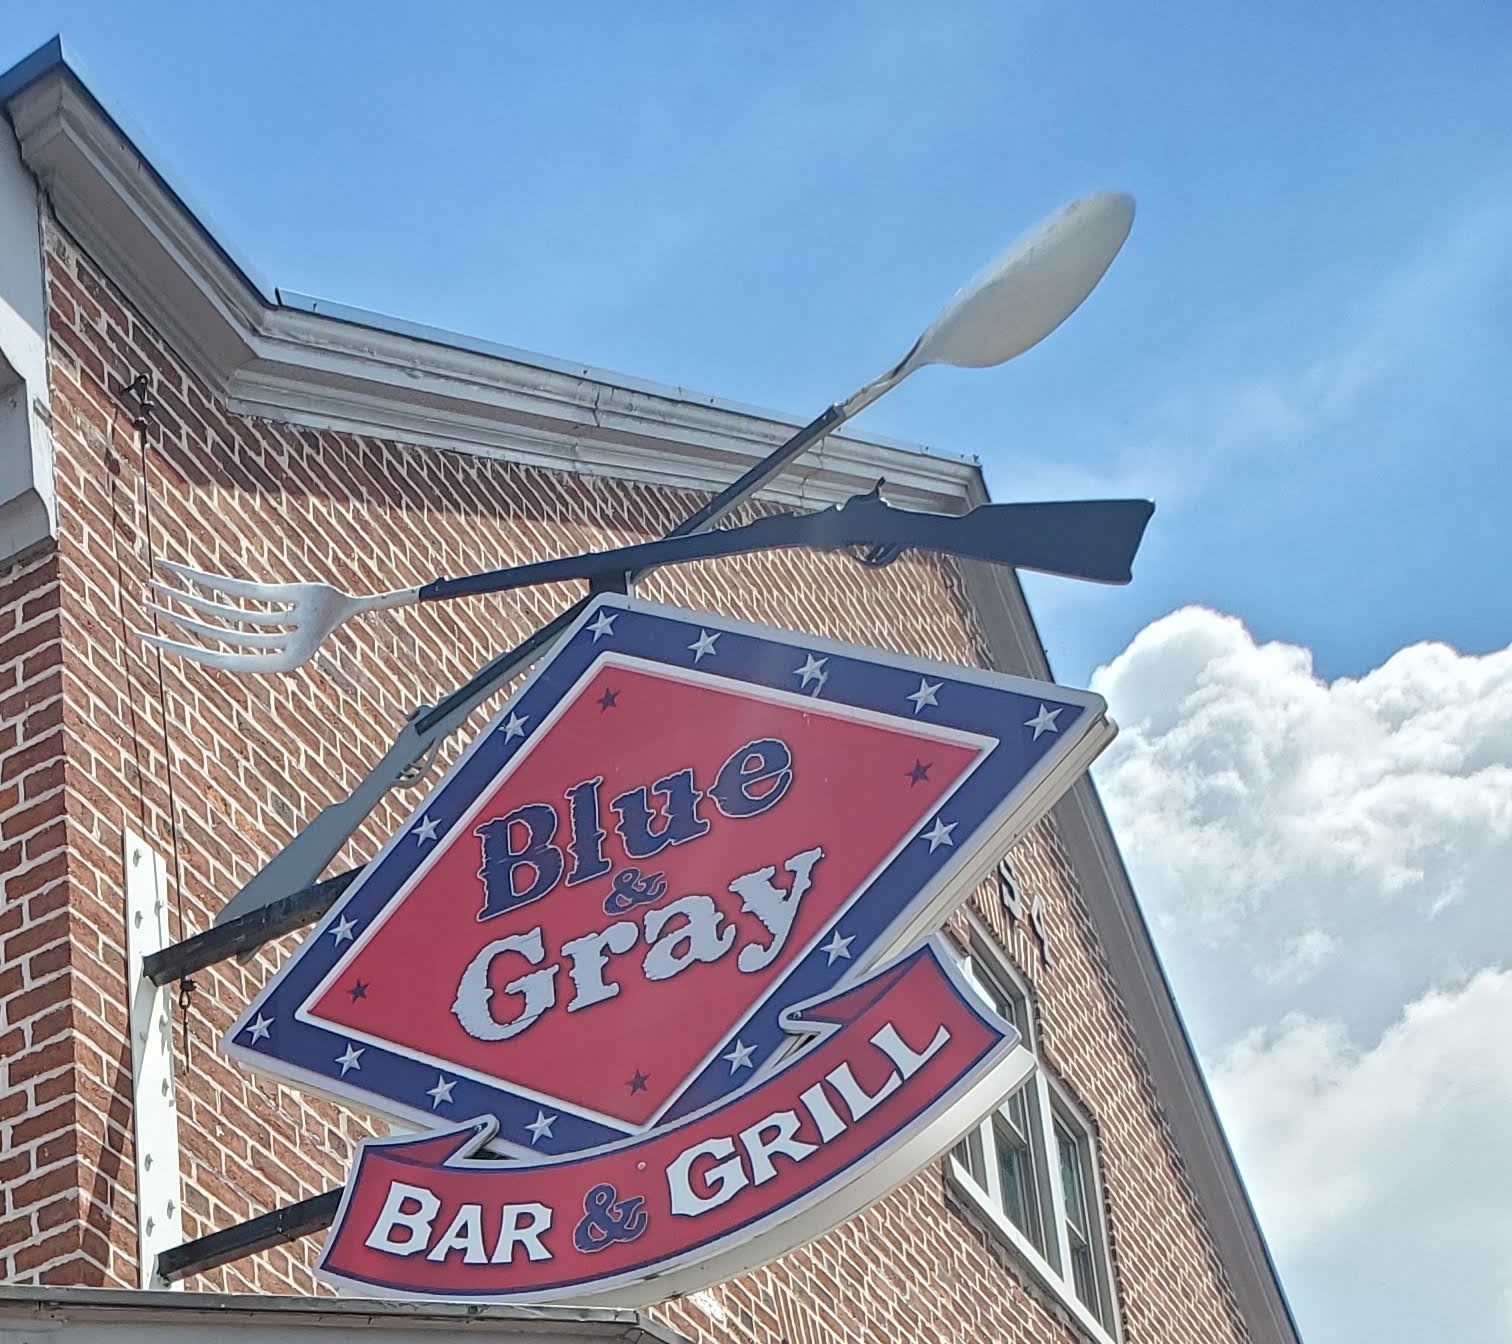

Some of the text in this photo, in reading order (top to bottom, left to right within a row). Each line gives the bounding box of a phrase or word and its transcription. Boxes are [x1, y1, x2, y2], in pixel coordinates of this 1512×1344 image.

[475, 737, 795, 923] Blue
[602, 867, 667, 918] &
[450, 847, 826, 1044] Gray
[366, 1021, 953, 1265] BAR & GRILL
